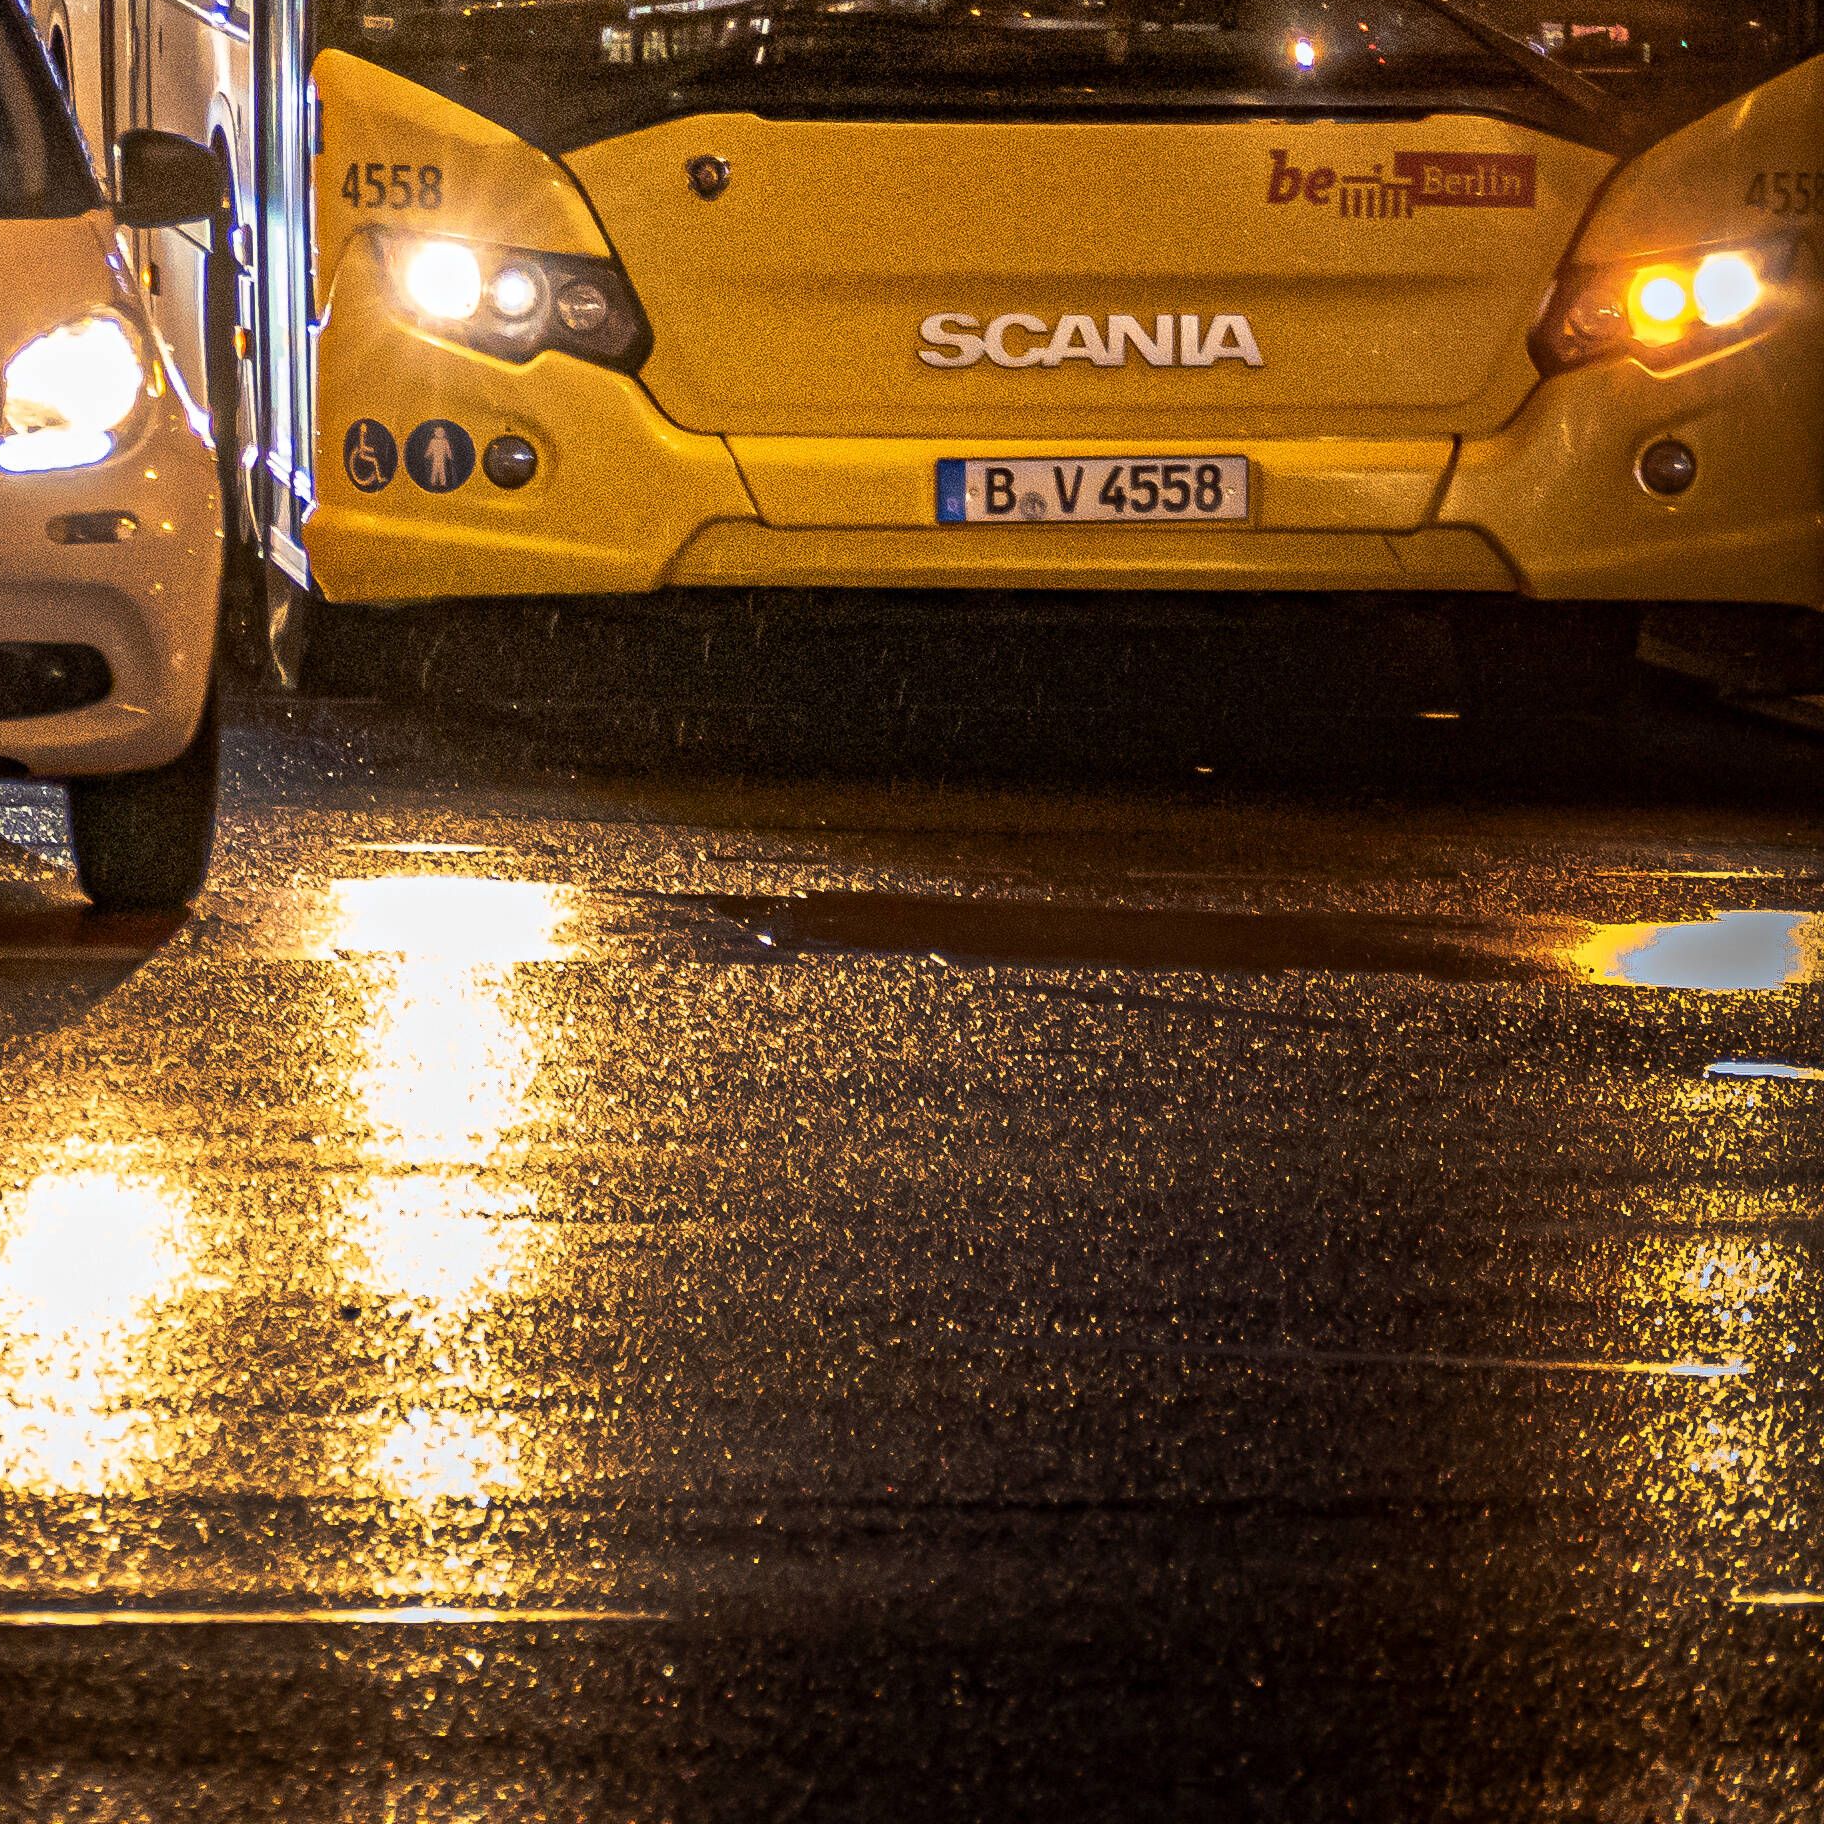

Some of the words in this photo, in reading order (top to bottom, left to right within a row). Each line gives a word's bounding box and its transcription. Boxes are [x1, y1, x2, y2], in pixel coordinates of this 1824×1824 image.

[341, 161, 444, 210] 4558
[1267, 148, 1336, 205] be
[1421, 163, 1523, 197] Berlin
[916, 312, 1266, 368] SCANIA
[984, 466, 1017, 515] B
[1052, 465, 1084, 514] V
[1098, 463, 1224, 514] 4558
